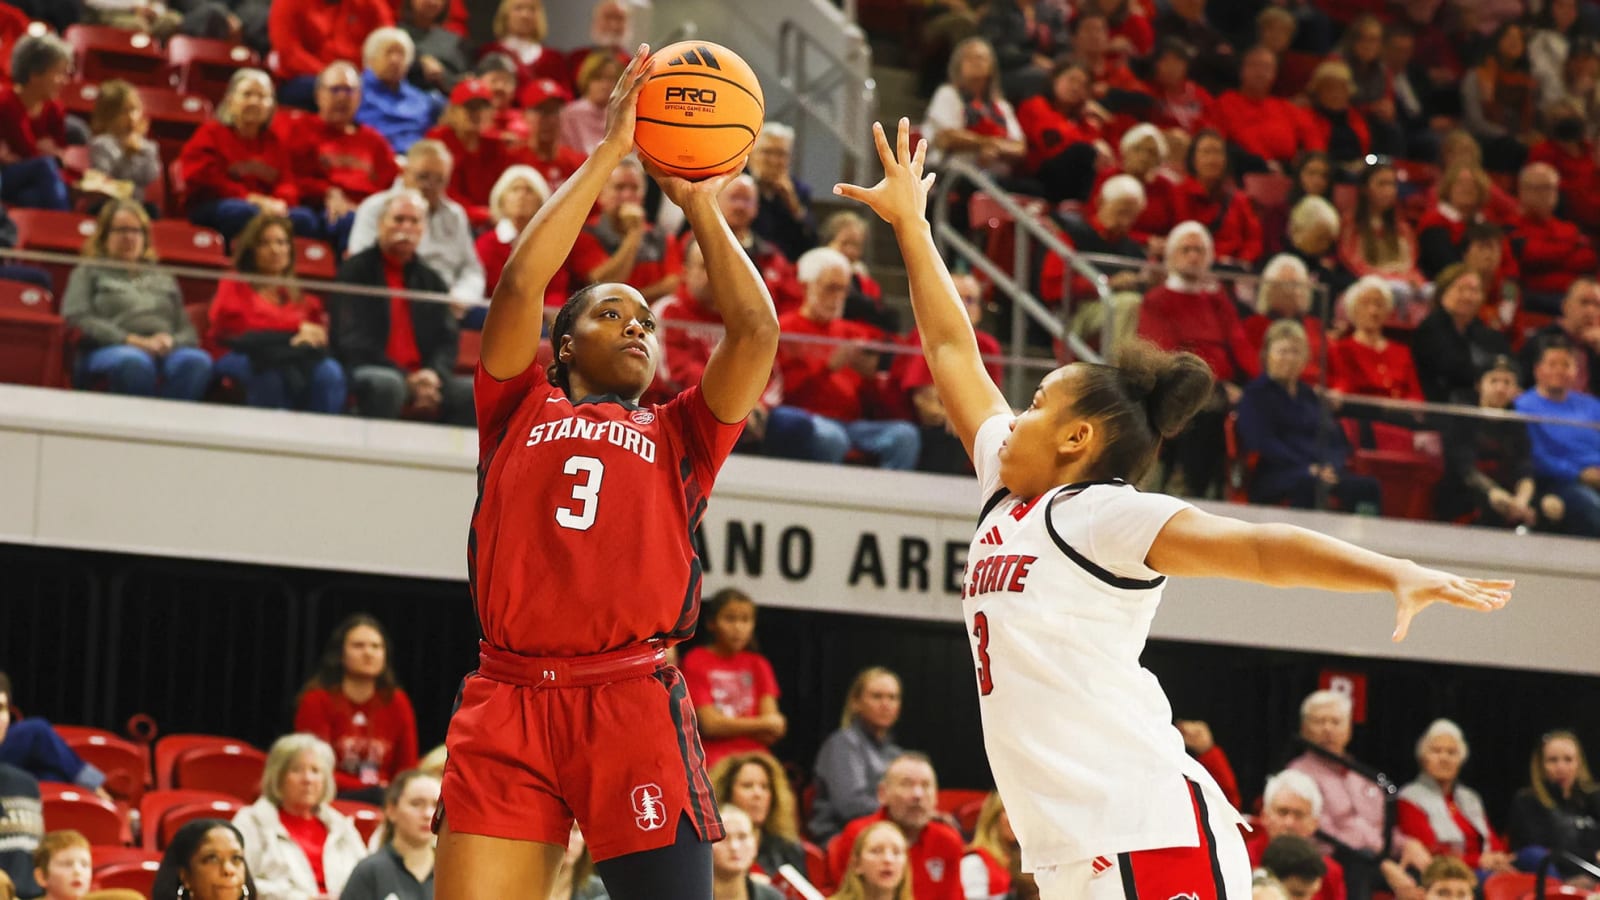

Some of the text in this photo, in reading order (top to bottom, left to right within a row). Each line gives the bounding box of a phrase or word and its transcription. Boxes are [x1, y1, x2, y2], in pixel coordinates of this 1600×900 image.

[666, 87, 717, 104] PRO
[526, 416, 656, 464] STANFORD
[555, 455, 605, 531] 3
[969, 554, 1039, 597] STATE
[973, 610, 994, 696] 3
